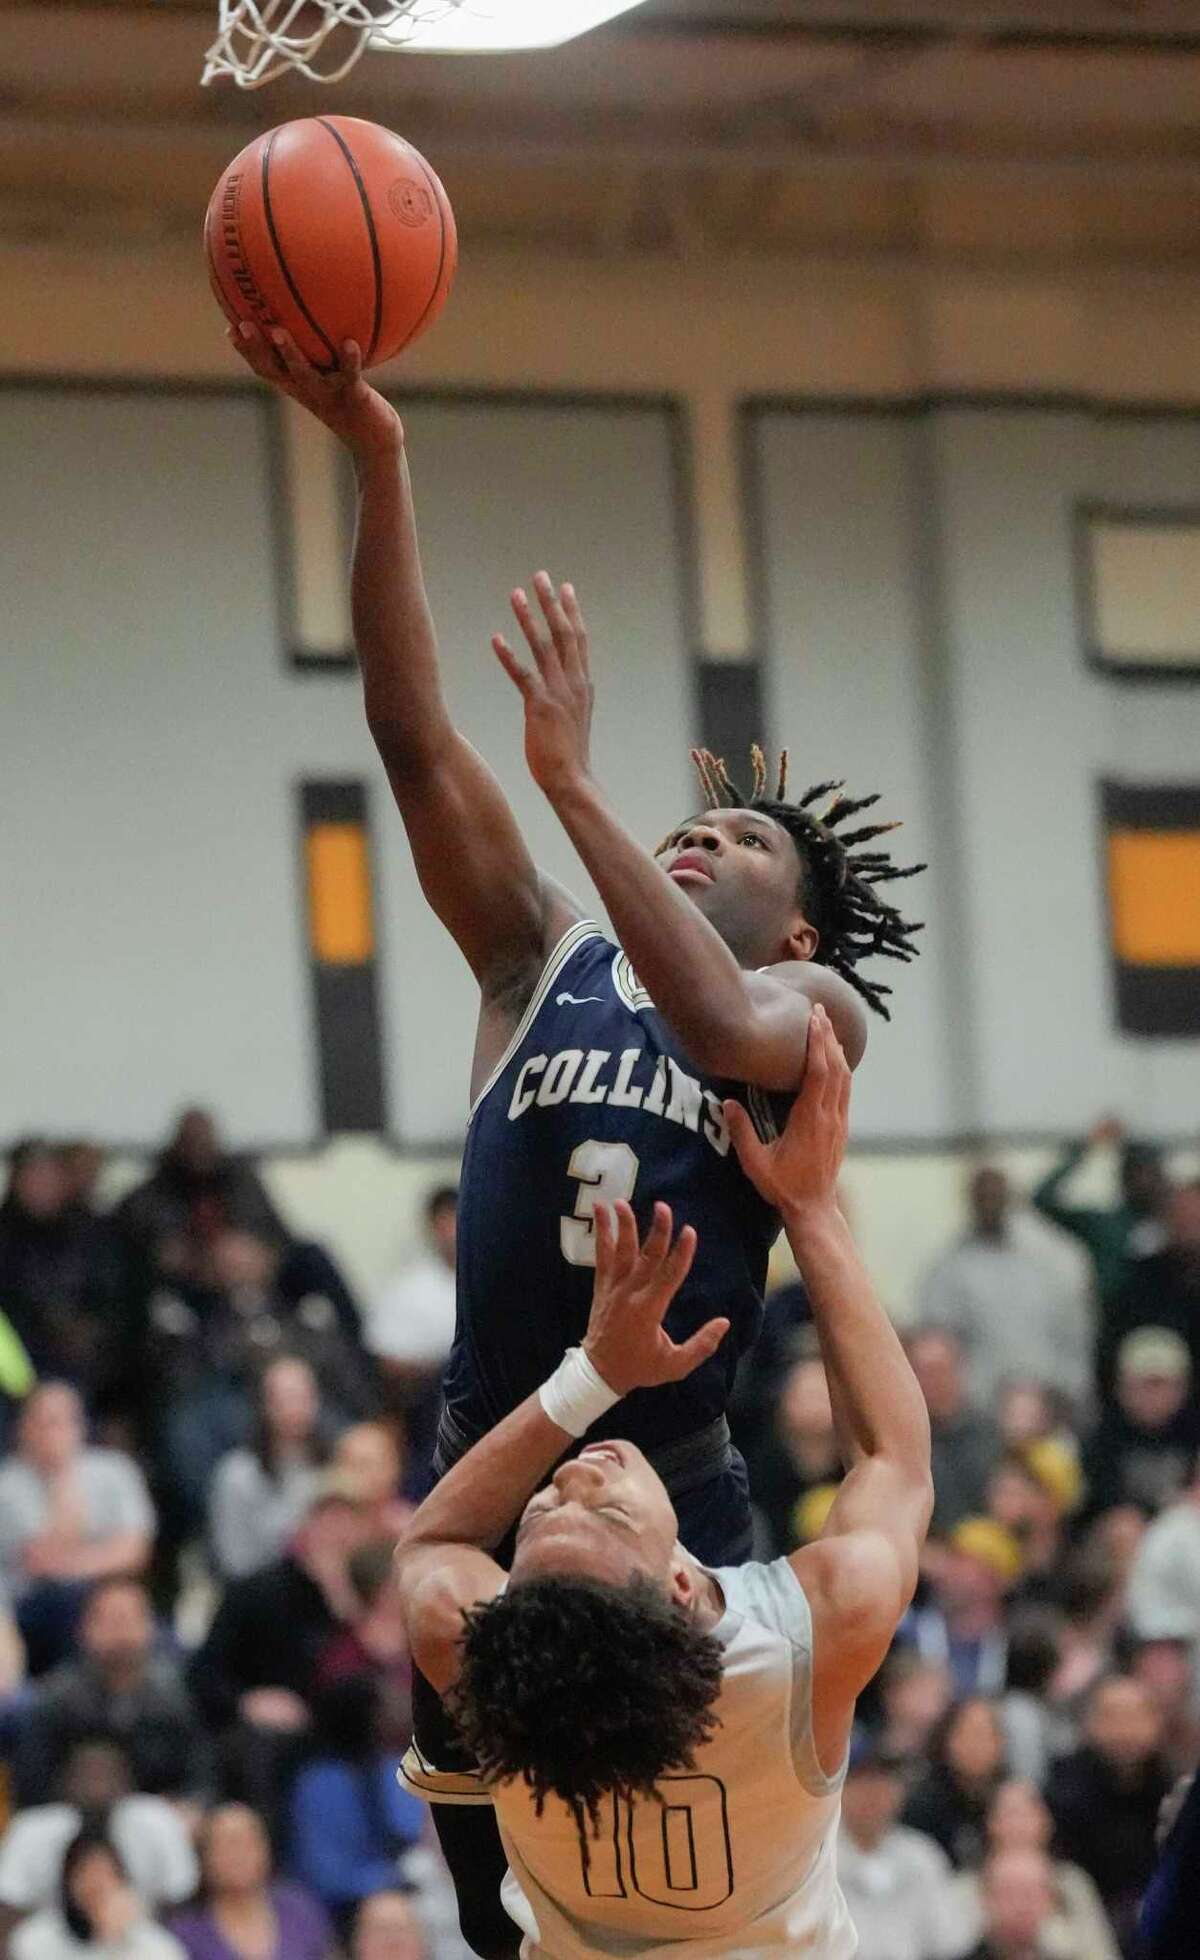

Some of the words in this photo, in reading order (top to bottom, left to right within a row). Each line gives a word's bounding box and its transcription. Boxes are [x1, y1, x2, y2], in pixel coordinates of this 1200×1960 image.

[507, 1047, 732, 1156] COLLINS
[559, 1138, 639, 1268] 3
[578, 1774, 734, 1911] 10
